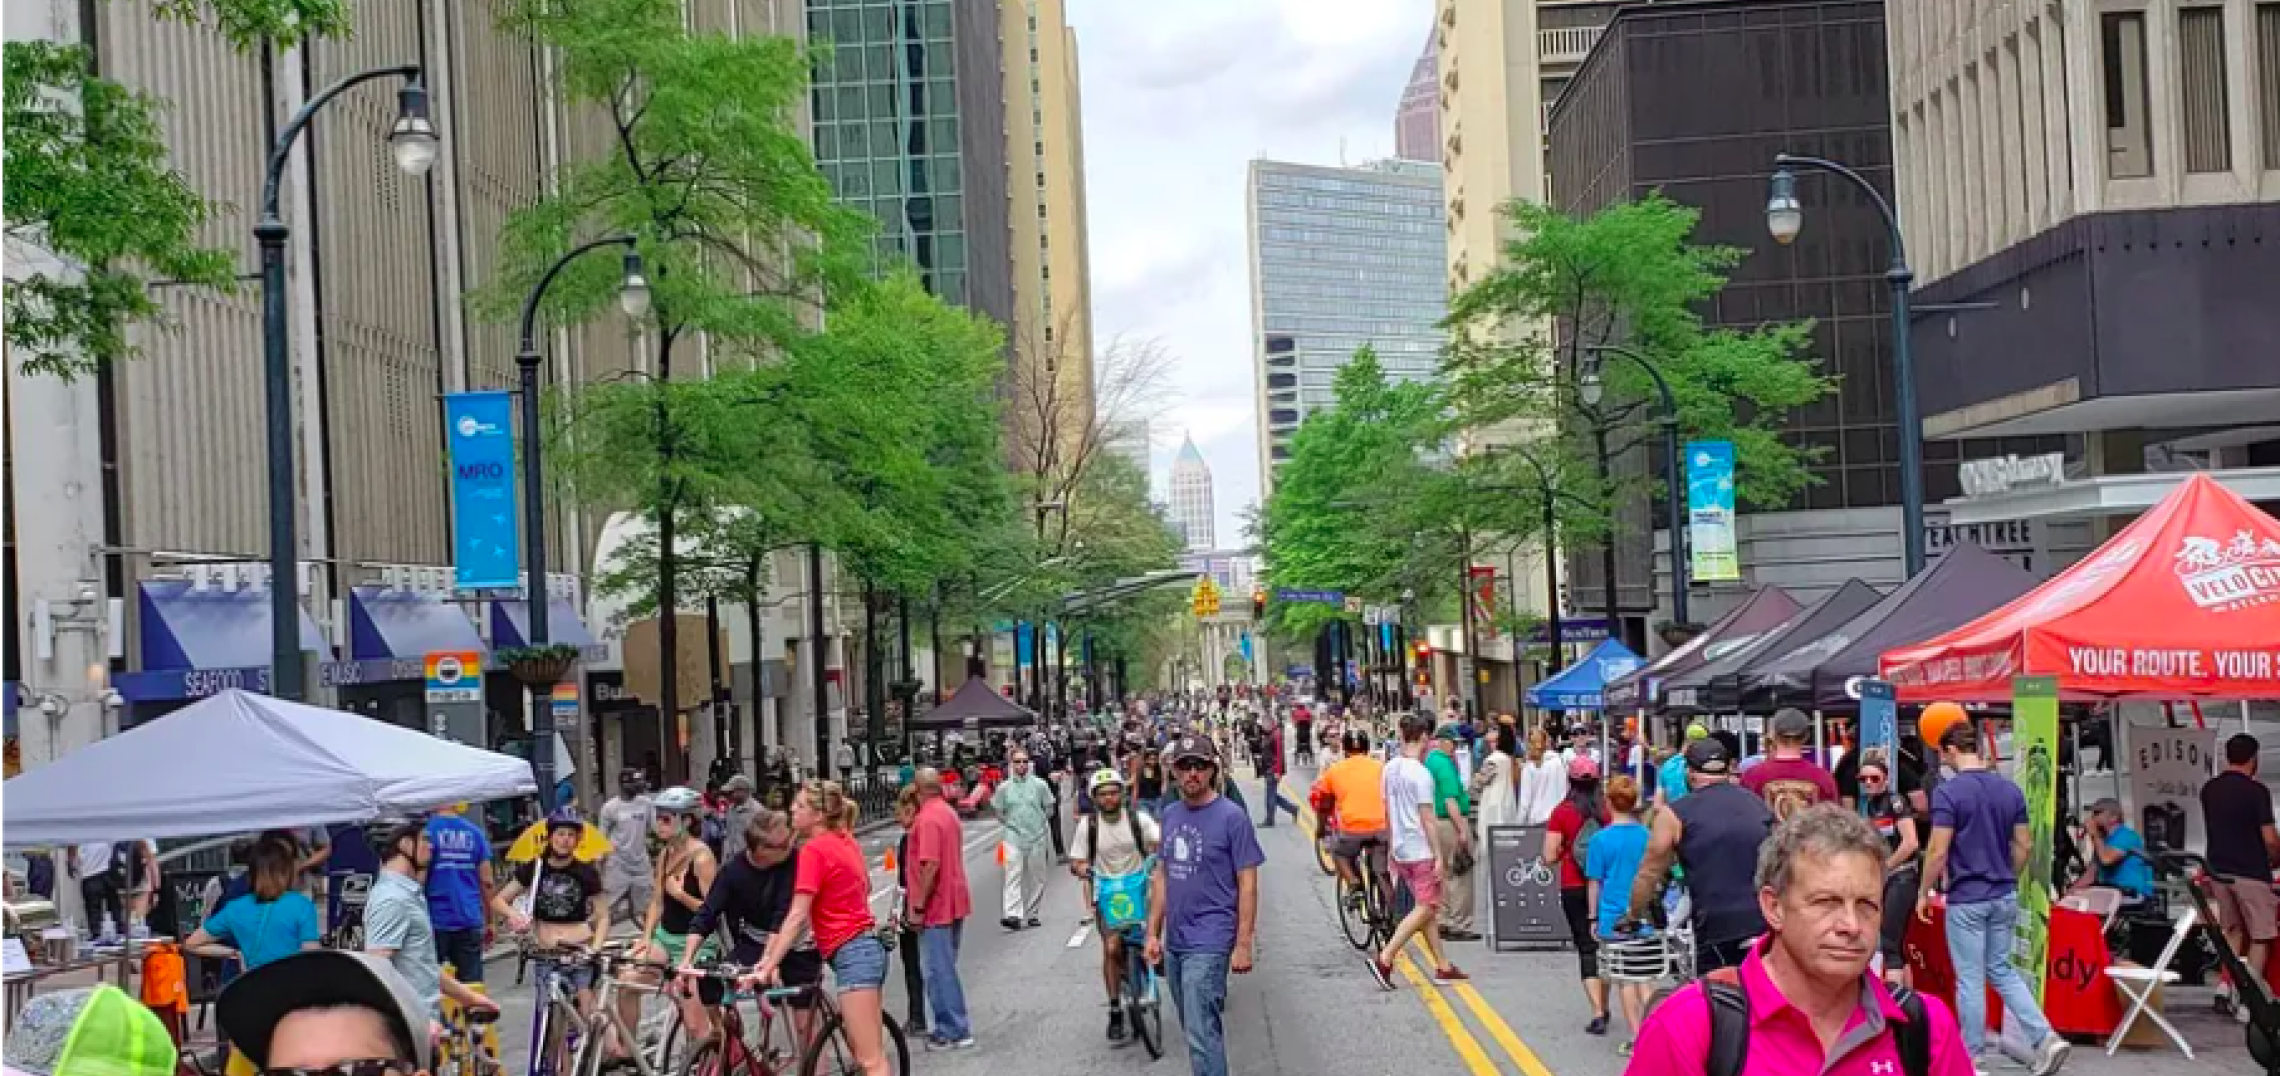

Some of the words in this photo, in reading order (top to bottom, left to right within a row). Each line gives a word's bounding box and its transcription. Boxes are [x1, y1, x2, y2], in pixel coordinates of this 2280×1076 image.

[459, 463, 504, 480] MRO
[2191, 571, 2249, 601] VELO
[2069, 646, 2128, 676] YOUR
[2132, 649, 2208, 677] ROUTE.
[2213, 651, 2271, 679] YOUR
[184, 668, 243, 697] SEAFOOD
[2140, 738, 2213, 777] EDISON
[2047, 948, 2098, 992] dy
